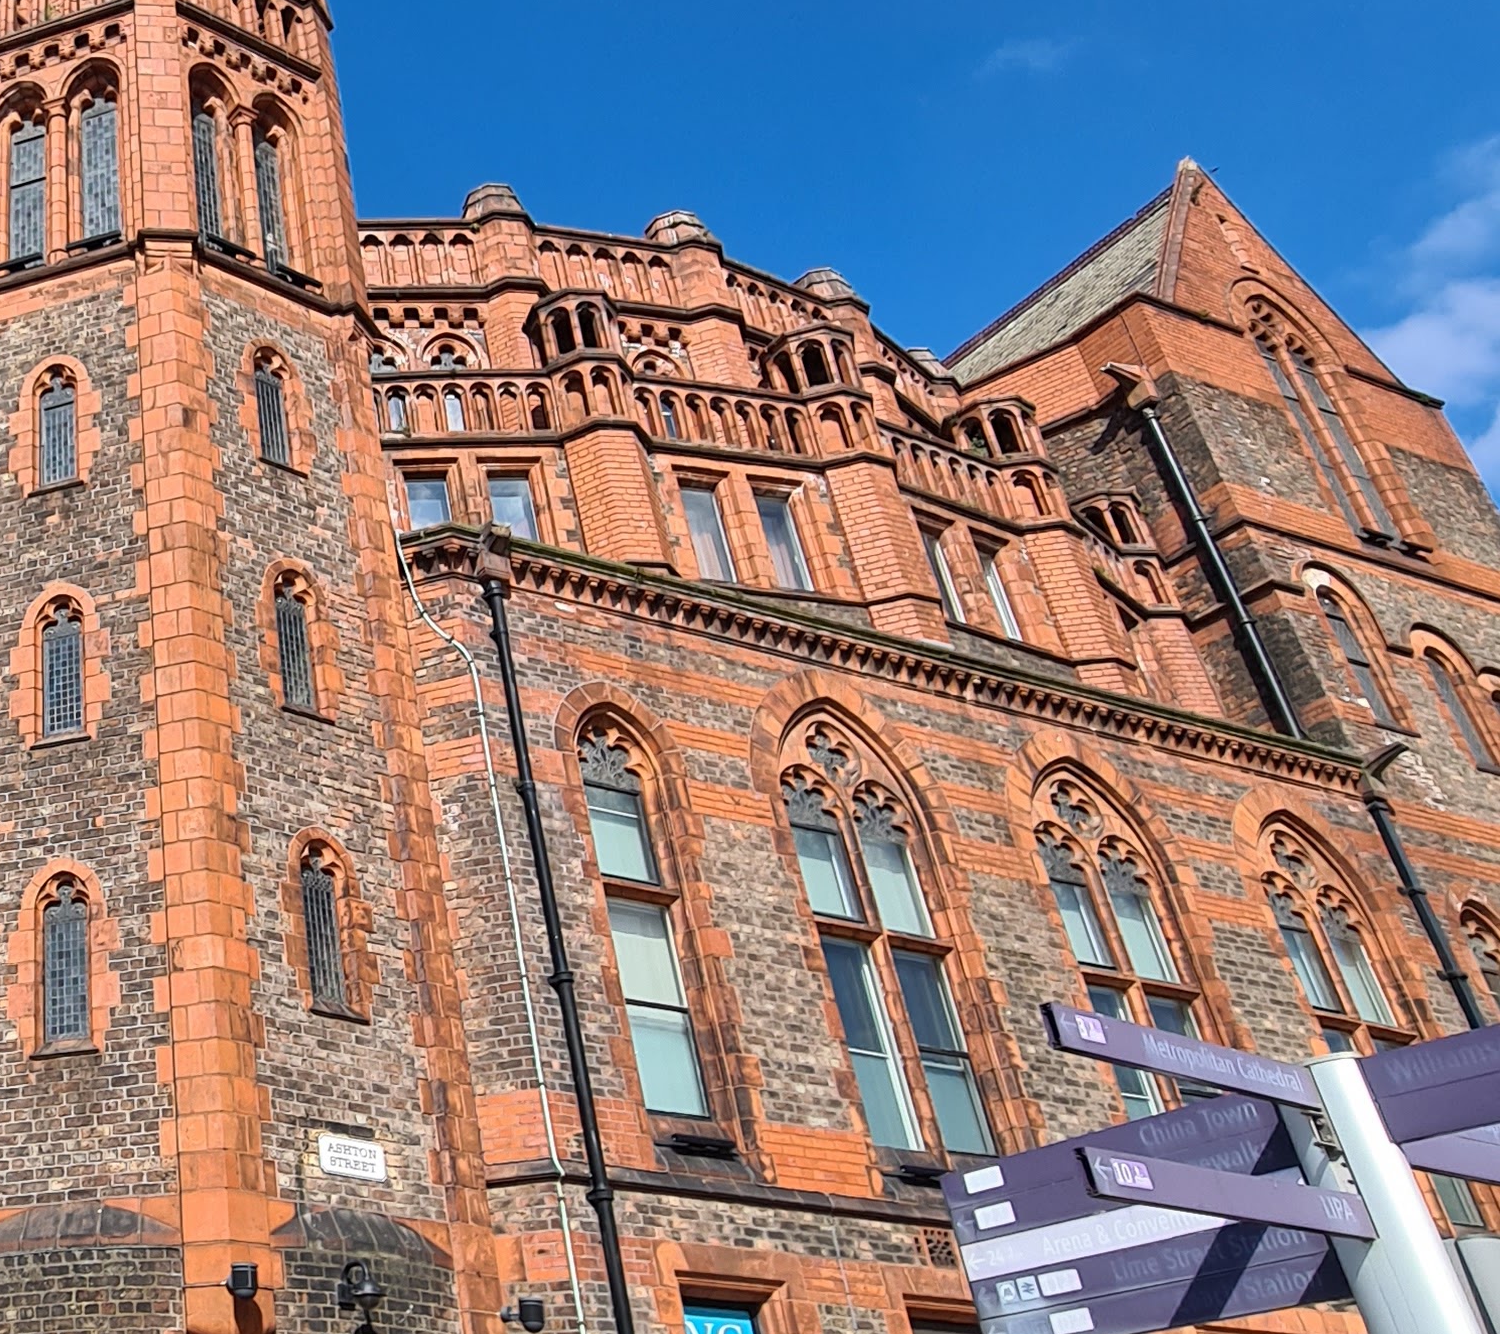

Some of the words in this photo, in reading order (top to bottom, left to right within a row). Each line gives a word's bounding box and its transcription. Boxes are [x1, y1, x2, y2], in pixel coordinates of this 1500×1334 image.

[1142, 1032, 1236, 1076] Metropolitan
[1237, 1057, 1305, 1093] Cathedral
[1139, 1117, 1197, 1147] China
[1197, 1101, 1258, 1137] Town
[327, 1142, 377, 1159] ASHTON
[330, 1155, 377, 1173] STREET
[1112, 1161, 1133, 1184] 10
[1319, 1195, 1357, 1222] LIPA
[1043, 1231, 1093, 1256] Arena
[1095, 1224, 1111, 1245] &
[1113, 1213, 1196, 1241] Conven
[1110, 1254, 1159, 1281] Lime
[1164, 1241, 1228, 1270] Street
[1228, 1228, 1308, 1254] Station
